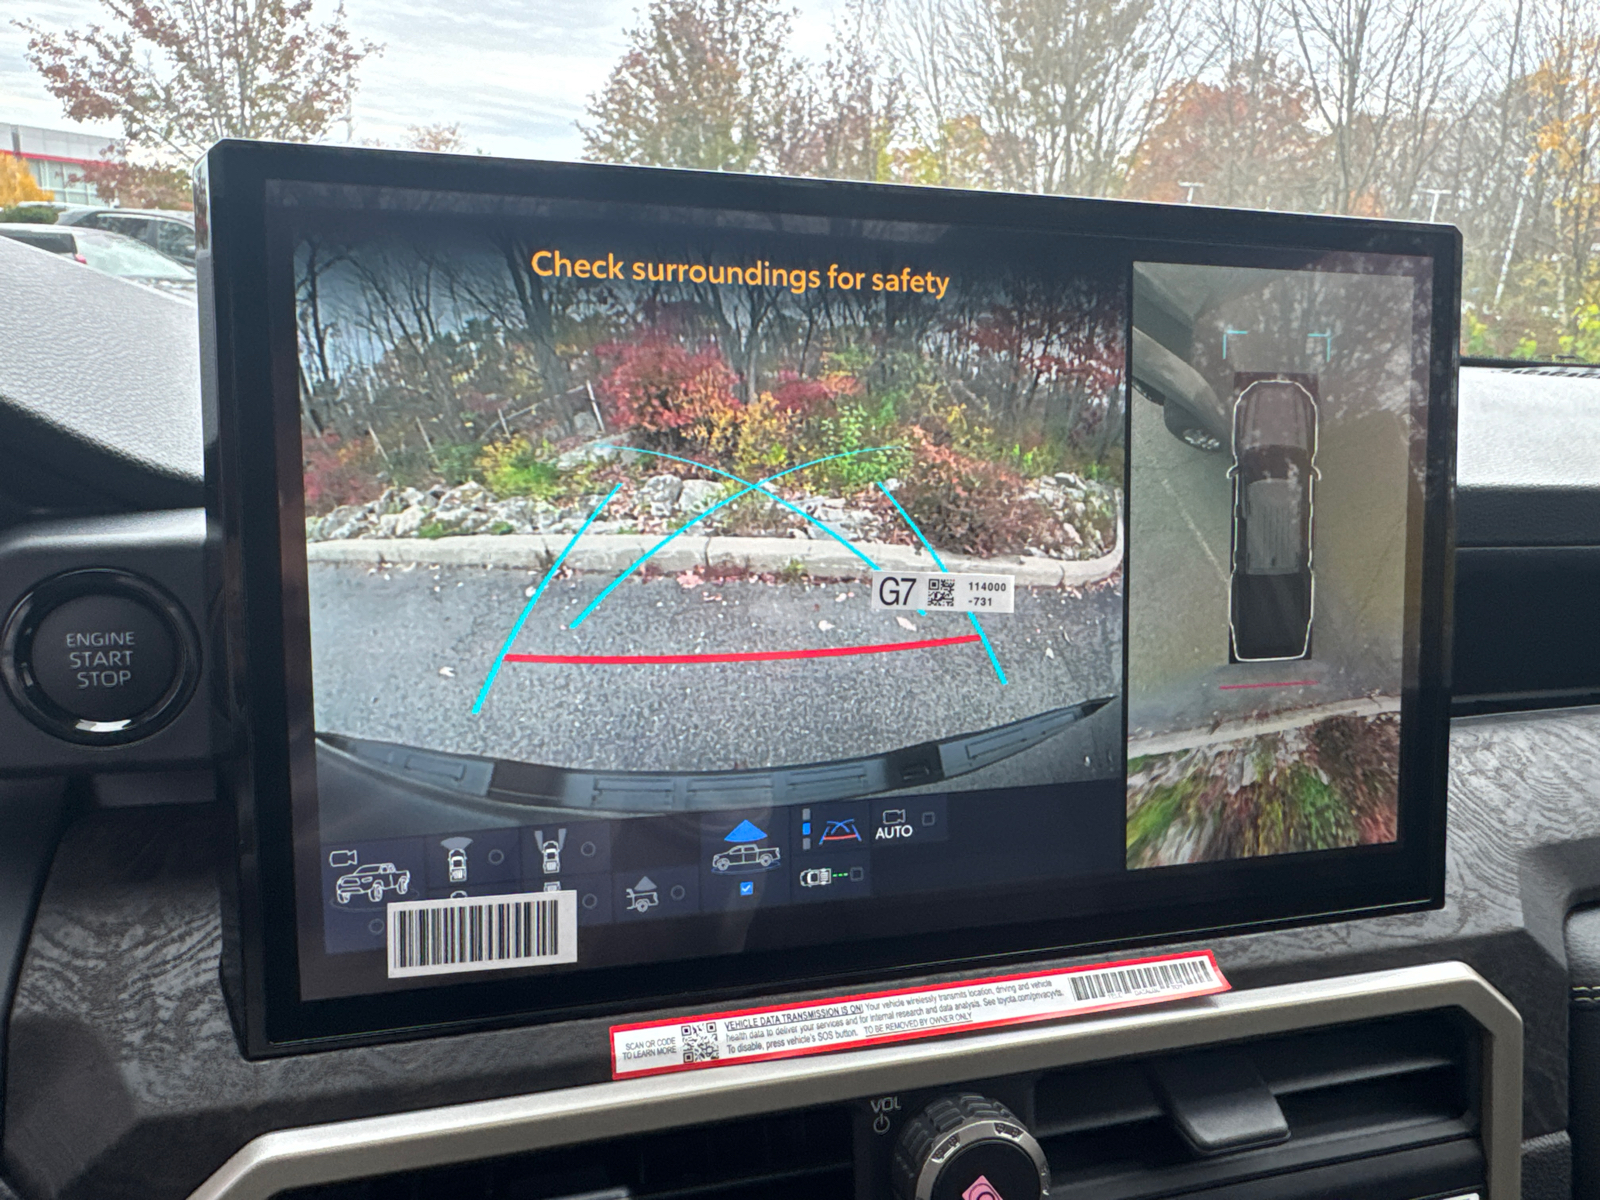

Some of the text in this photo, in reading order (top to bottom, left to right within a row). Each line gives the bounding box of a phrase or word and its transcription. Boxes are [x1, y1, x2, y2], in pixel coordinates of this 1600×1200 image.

[531, 250, 950, 300] Check surroundings for safety
[879, 576, 917, 606] G7
[968, 582, 1006, 592] 114000
[968, 597, 992, 606] -731
[66, 632, 135, 647] ENGINE
[69, 650, 133, 669] START
[77, 671, 131, 689] STOP
[875, 825, 913, 840] AUTO
[724, 1018, 758, 1030] VEHICLE
[760, 1015, 780, 1026] DATA
[781, 1007, 839, 1021] TRANSMISSION
[841, 1005, 848, 1014] IS
[865, 1002, 880, 1011] Your
[882, 999, 904, 1009] vehicle
[906, 994, 937, 1004] wirelessly
[938, 990, 967, 1001] transmits
[968, 987, 995, 997] location,
[995, 984, 1017, 994] driving
[1018, 982, 1030, 991] and
[1031, 979, 1052, 989] vehicle
[726, 1031, 748, 1042] health
[749, 1029, 764, 1039] data
[766, 1029, 773, 1037] to
[775, 1024, 798, 1035] deliver
[800, 1023, 814, 1034] your
[816, 1019, 844, 1030] services
[845, 1016, 858, 1026] and
[859, 1015, 868, 1024] for
[870, 1011, 894, 1021] internal
[896, 1007, 924, 1018] research
[925, 1005, 938, 1015] and
[939, 1003, 953, 1012] data
[982, 998, 996, 1007] See
[727, 1012, 972, 1054] To disable, press vehicle's SOS button. TO BE REMOVED BY OWNER ONLY
[622, 1046, 677, 1060] TO LEARN MORE
[625, 1041, 644, 1051] SCAN
[657, 1037, 676, 1046] CODE
[870, 1096, 902, 1114] VOL
